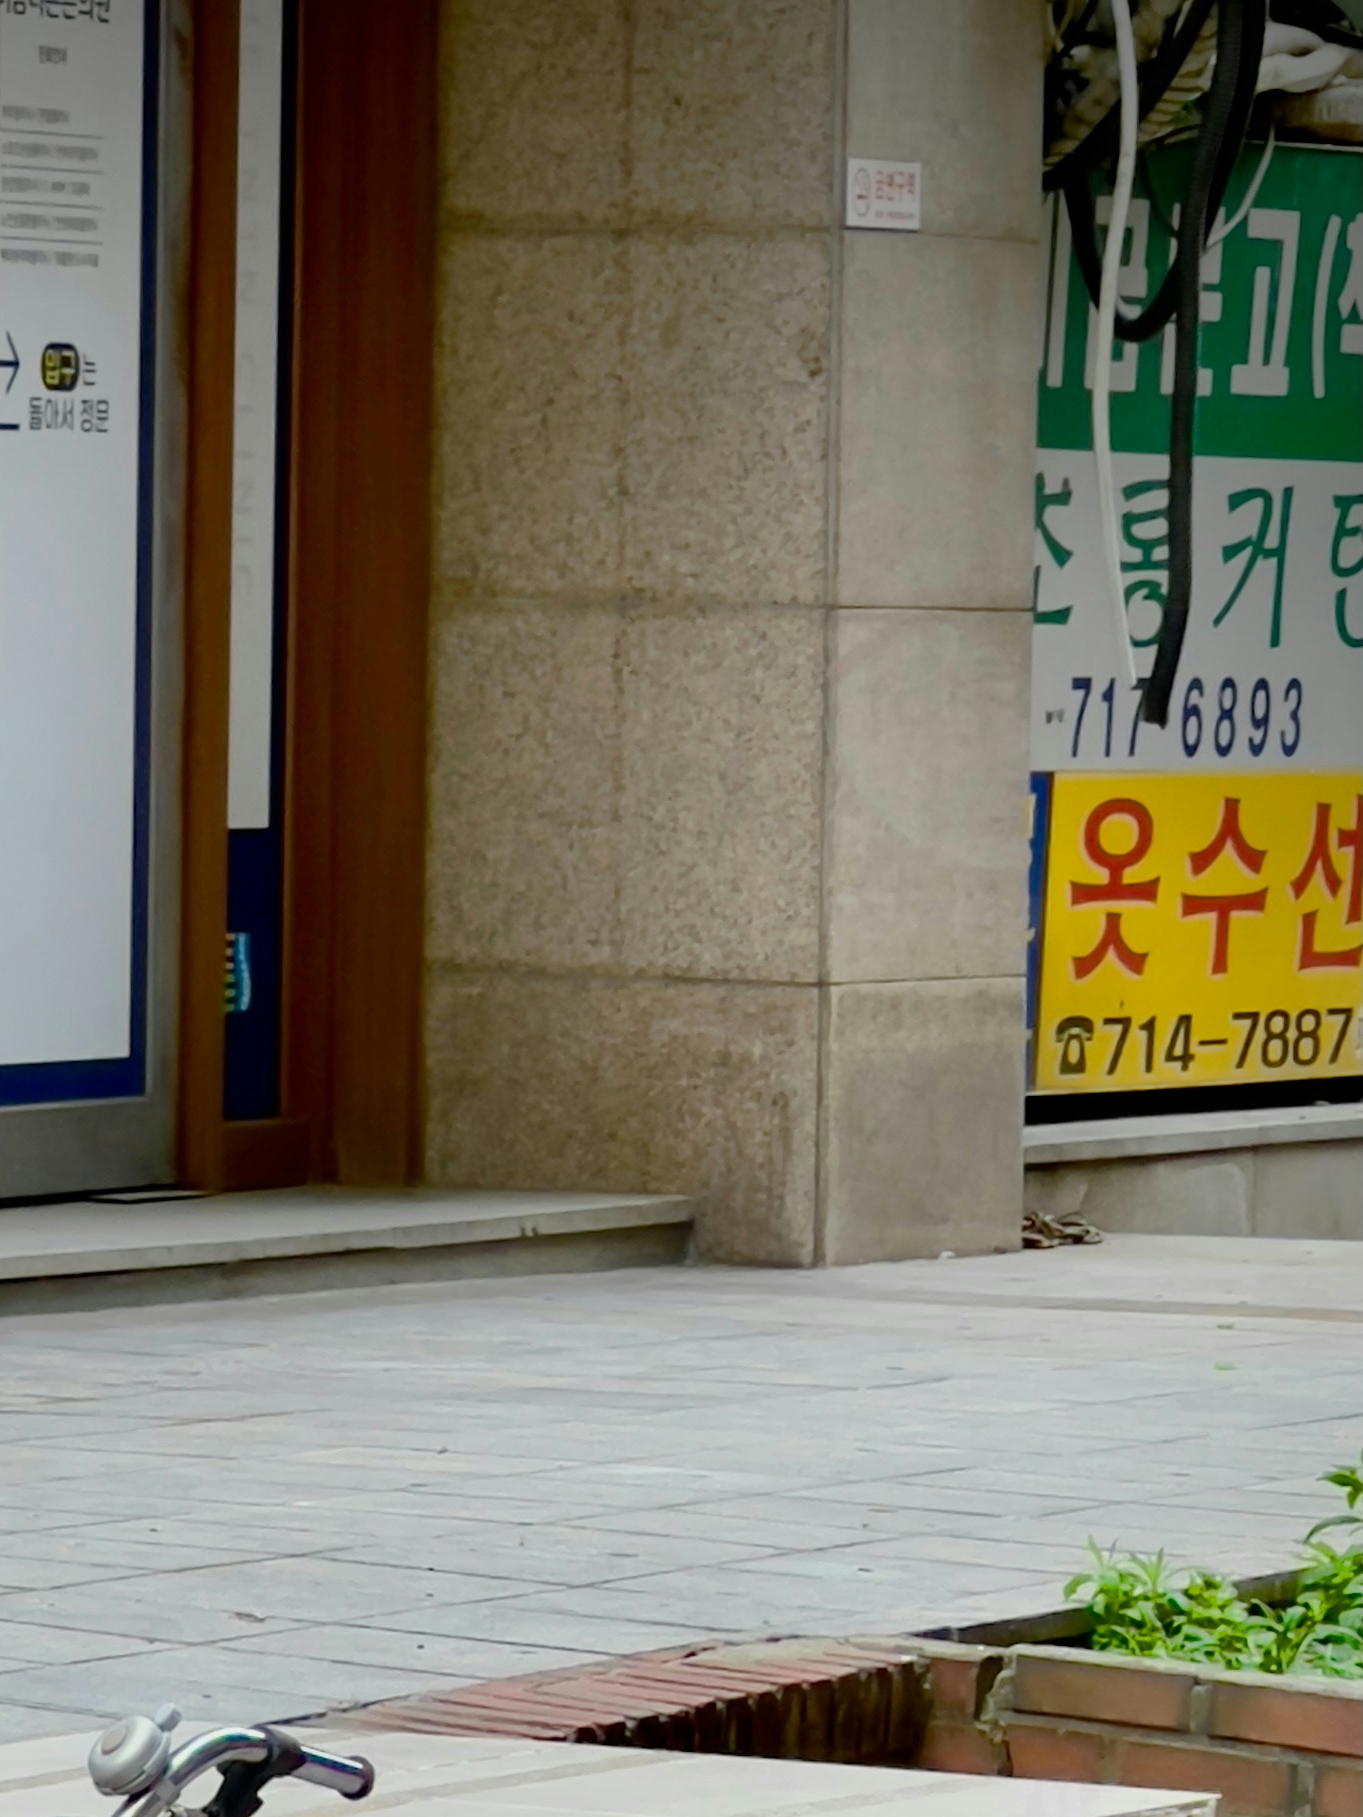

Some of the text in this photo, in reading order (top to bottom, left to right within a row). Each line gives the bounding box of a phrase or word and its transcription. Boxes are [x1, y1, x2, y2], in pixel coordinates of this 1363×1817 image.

[29, 397, 110, 433] 돌아서 정문
[1069, 795, 1363, 981] 옷수선
[1102, 1008, 1354, 1077] 714-7887
